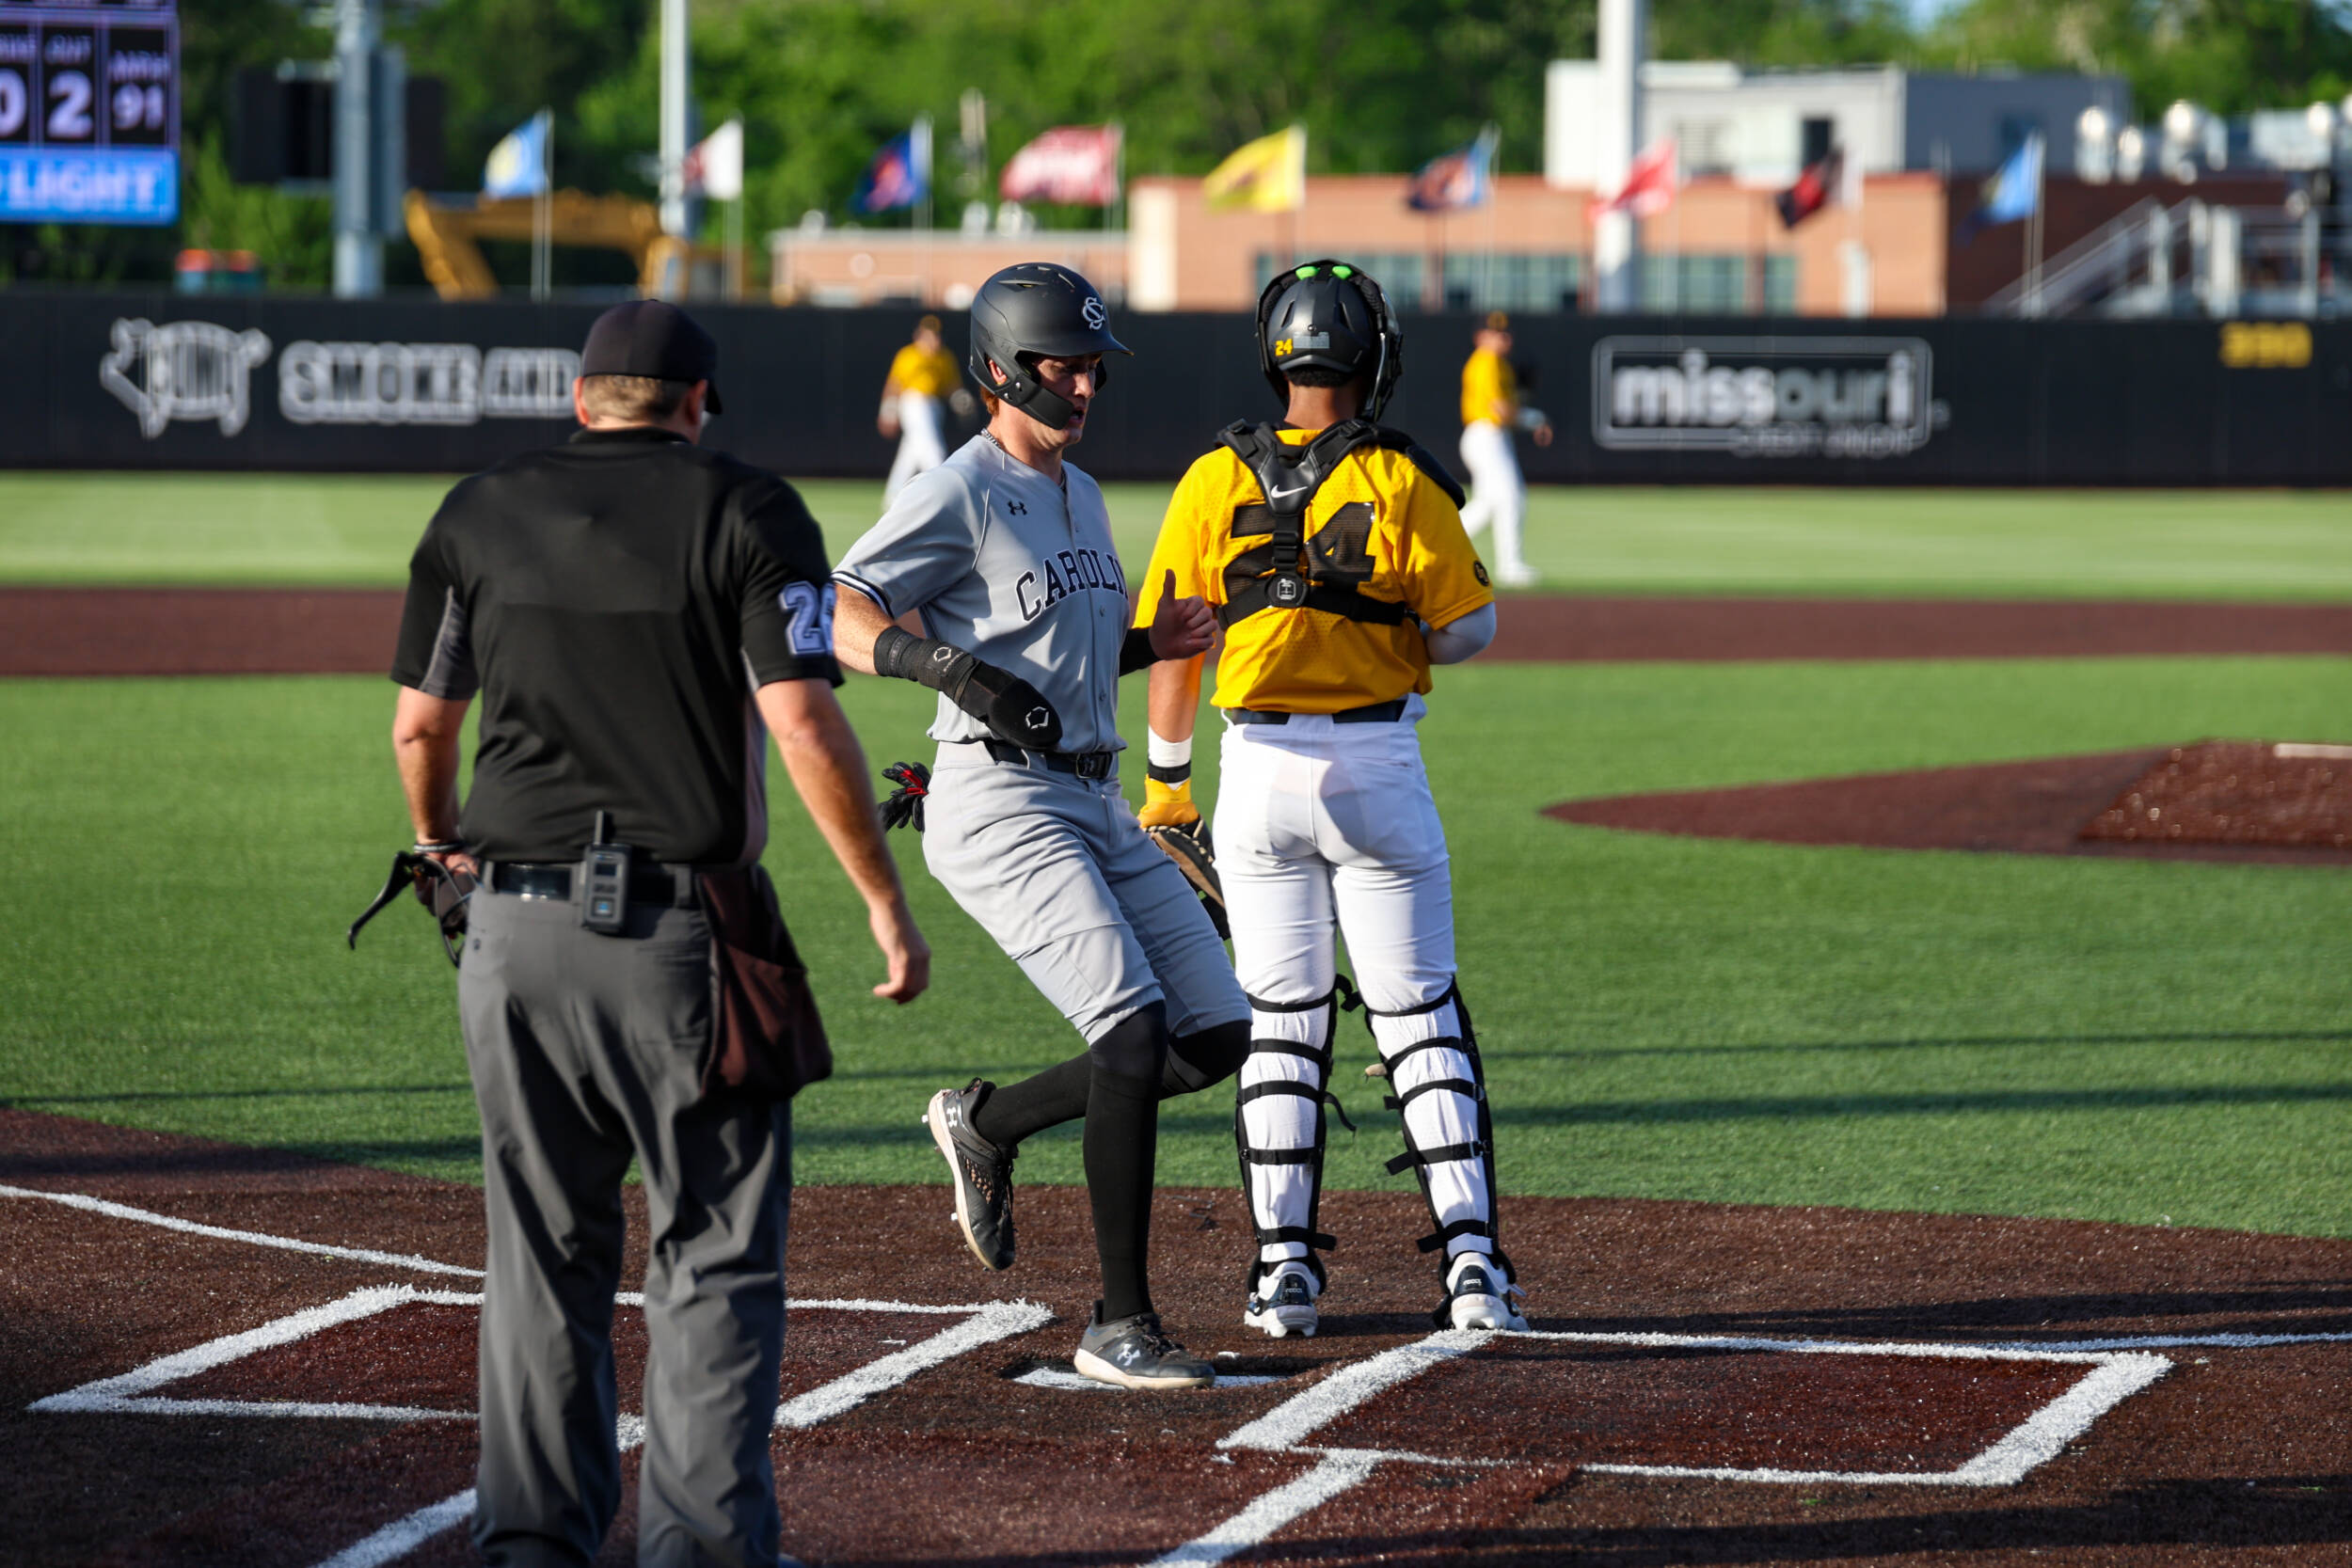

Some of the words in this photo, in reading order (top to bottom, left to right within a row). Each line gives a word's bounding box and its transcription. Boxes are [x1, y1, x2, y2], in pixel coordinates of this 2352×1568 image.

[47, 70, 92, 137] 2
[113, 83, 164, 130] 91
[1275, 339, 1293, 356] 24
[278, 340, 482, 425] SMOKE
[1613, 347, 1915, 428] missouri
